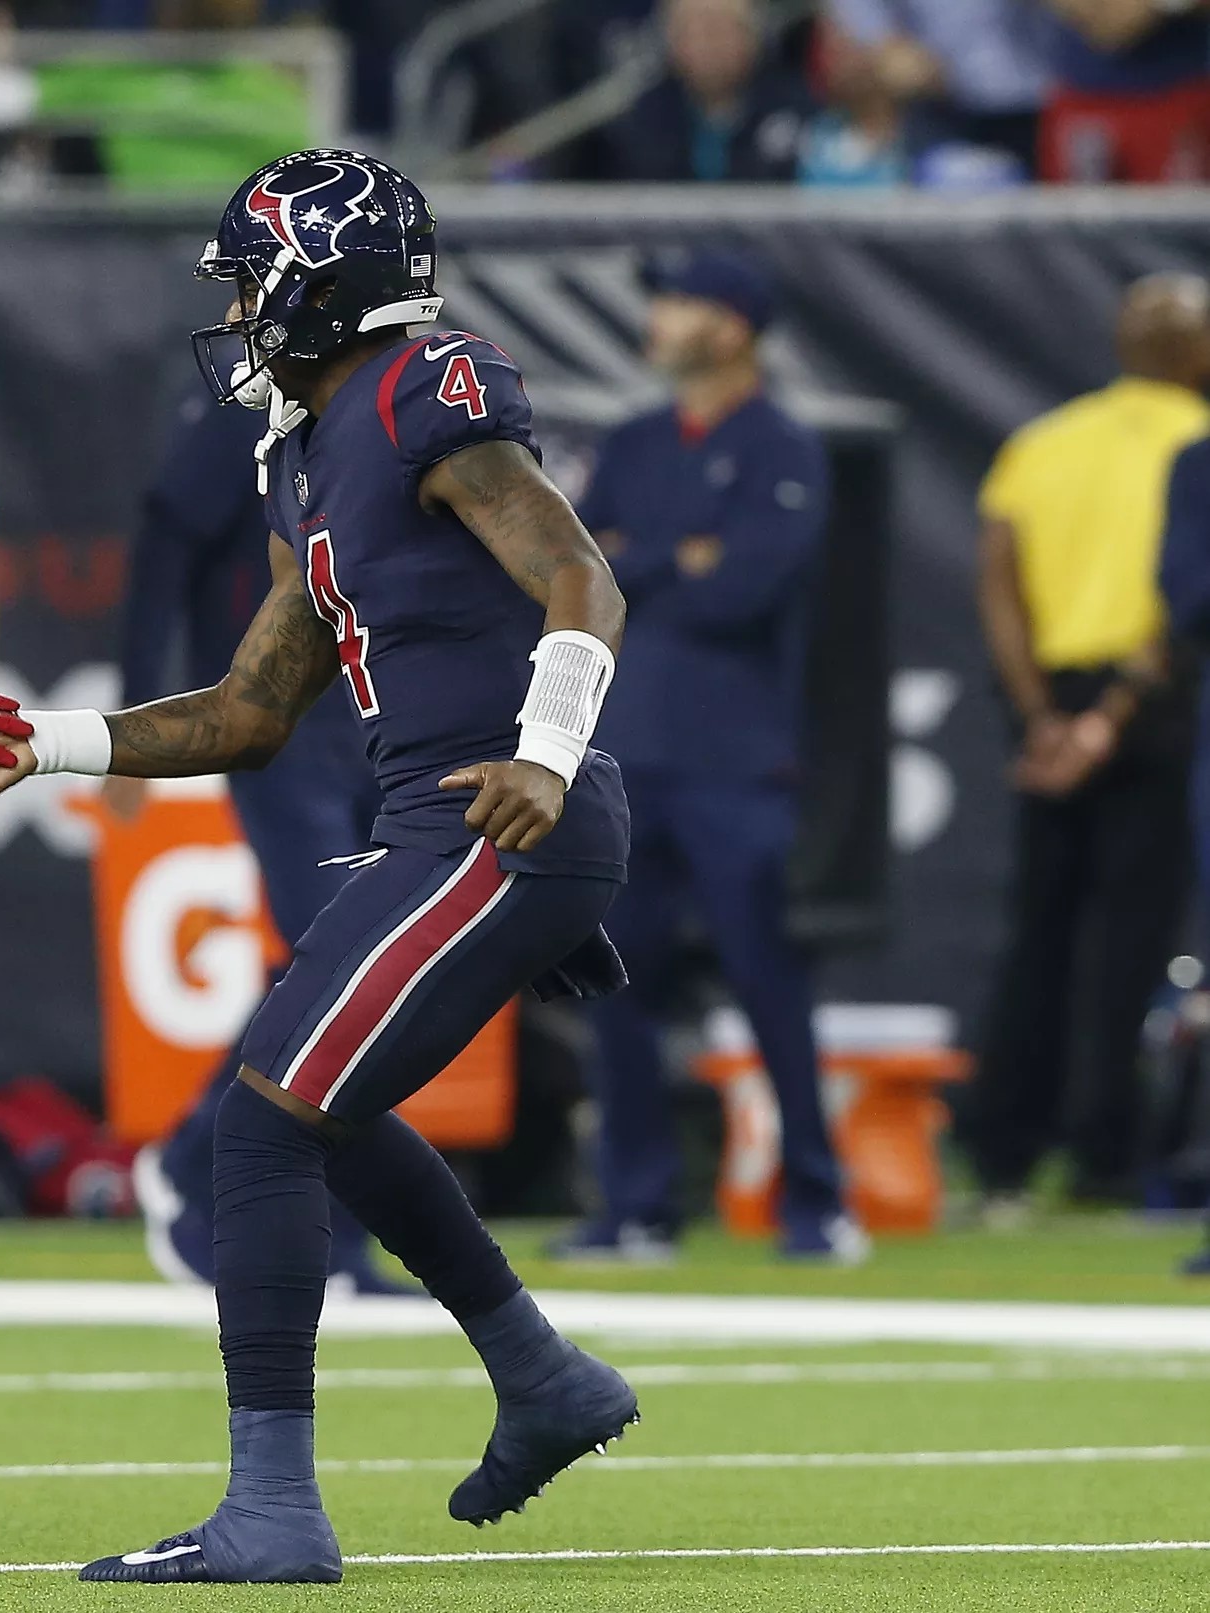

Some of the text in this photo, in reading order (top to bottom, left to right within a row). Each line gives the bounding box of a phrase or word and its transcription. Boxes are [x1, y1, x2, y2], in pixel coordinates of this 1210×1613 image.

[436, 354, 488, 420] 4
[307, 528, 381, 720] 4
[120, 840, 266, 1051] G
